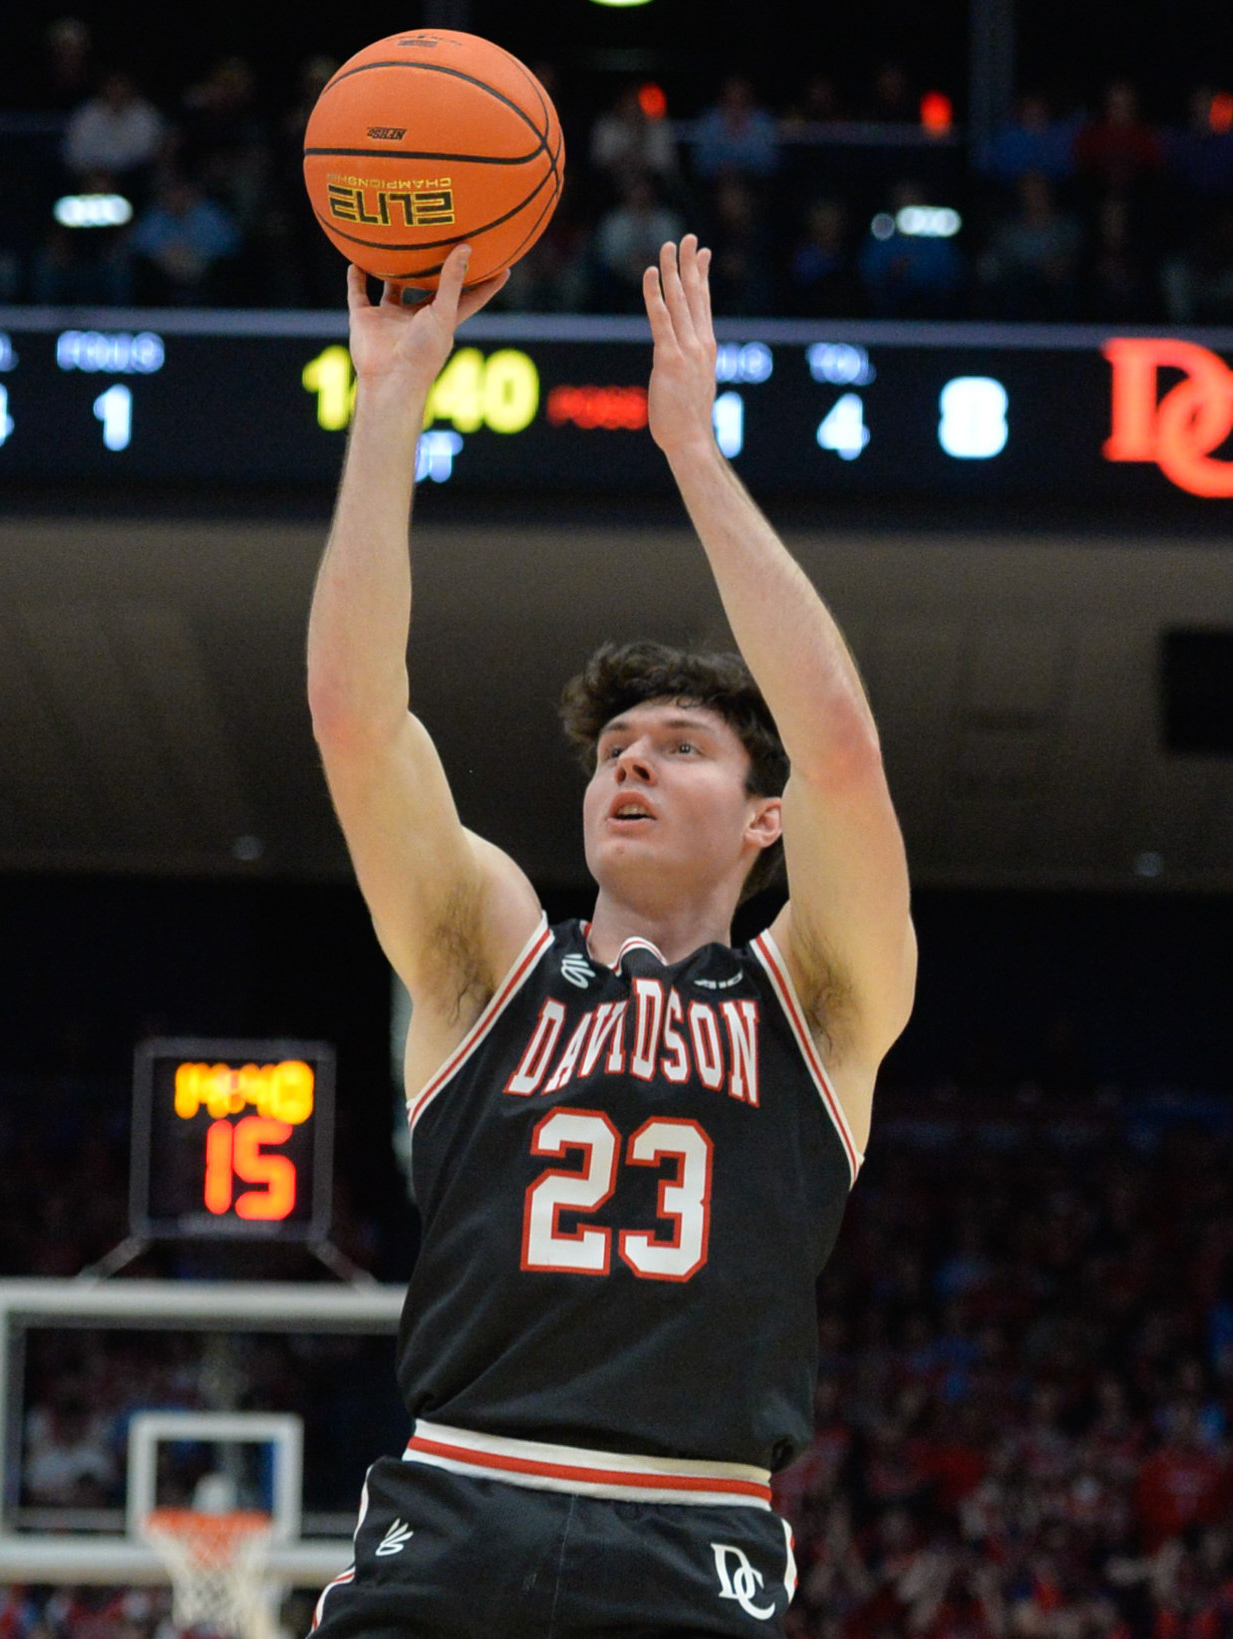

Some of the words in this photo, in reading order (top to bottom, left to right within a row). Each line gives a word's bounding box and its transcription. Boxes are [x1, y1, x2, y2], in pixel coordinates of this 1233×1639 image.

[327, 183, 456, 227] ELITE
[93, 384, 132, 451] 1
[817, 393, 871, 461] 4
[938, 376, 1009, 459] 8
[503, 977, 761, 1108] DAVIDSON
[204, 1116, 297, 1221] 15
[520, 1106, 714, 1283] 23
[711, 1543, 775, 1621] DC
